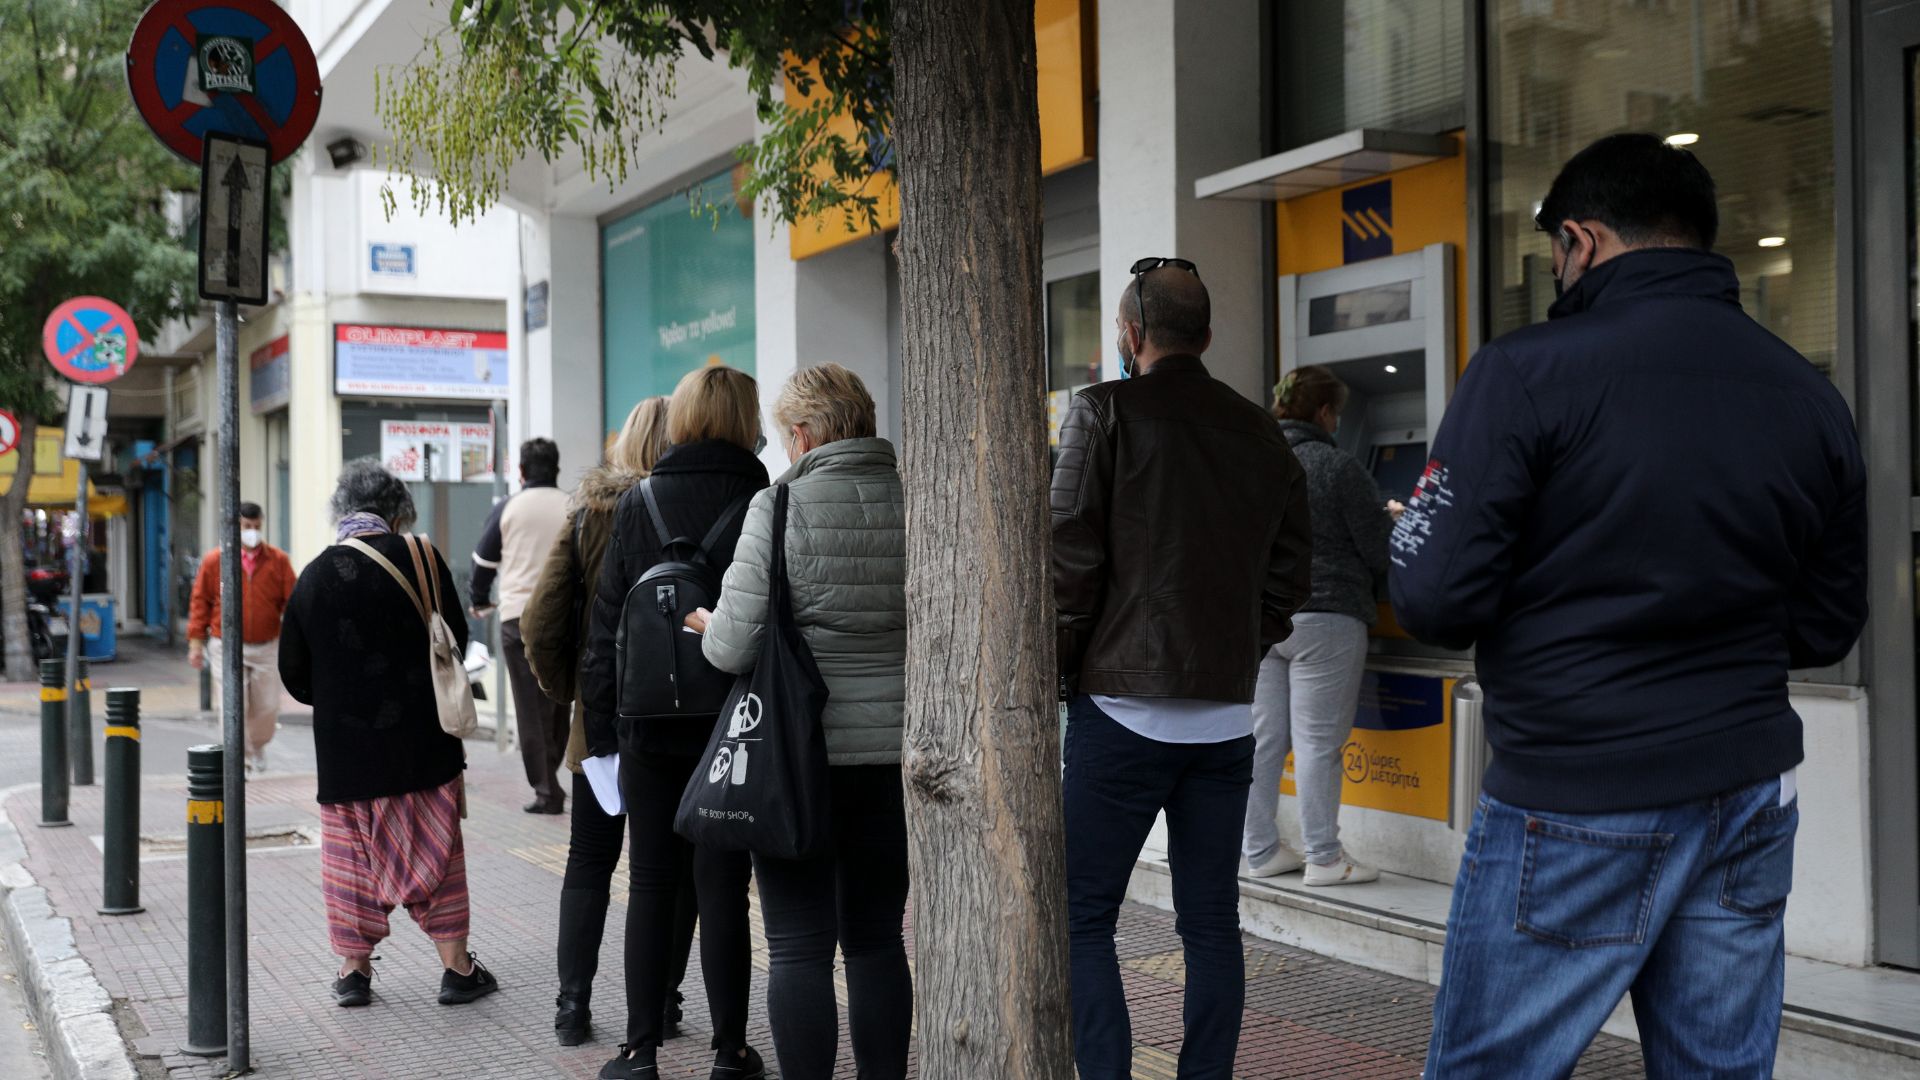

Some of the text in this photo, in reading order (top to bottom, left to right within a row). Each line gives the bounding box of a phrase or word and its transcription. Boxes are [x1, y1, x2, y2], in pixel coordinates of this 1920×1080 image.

[346, 327, 477, 349] OLIMPLAST
[387, 424, 449, 436] ΠΡΟΣΦΟΡΑ
[1347, 753, 1362, 771] 24
[1371, 750, 1402, 772] ώρες
[1371, 769, 1420, 789] μετρητά
[698, 807, 708, 817] THE
[710, 809, 726, 819] BODY
